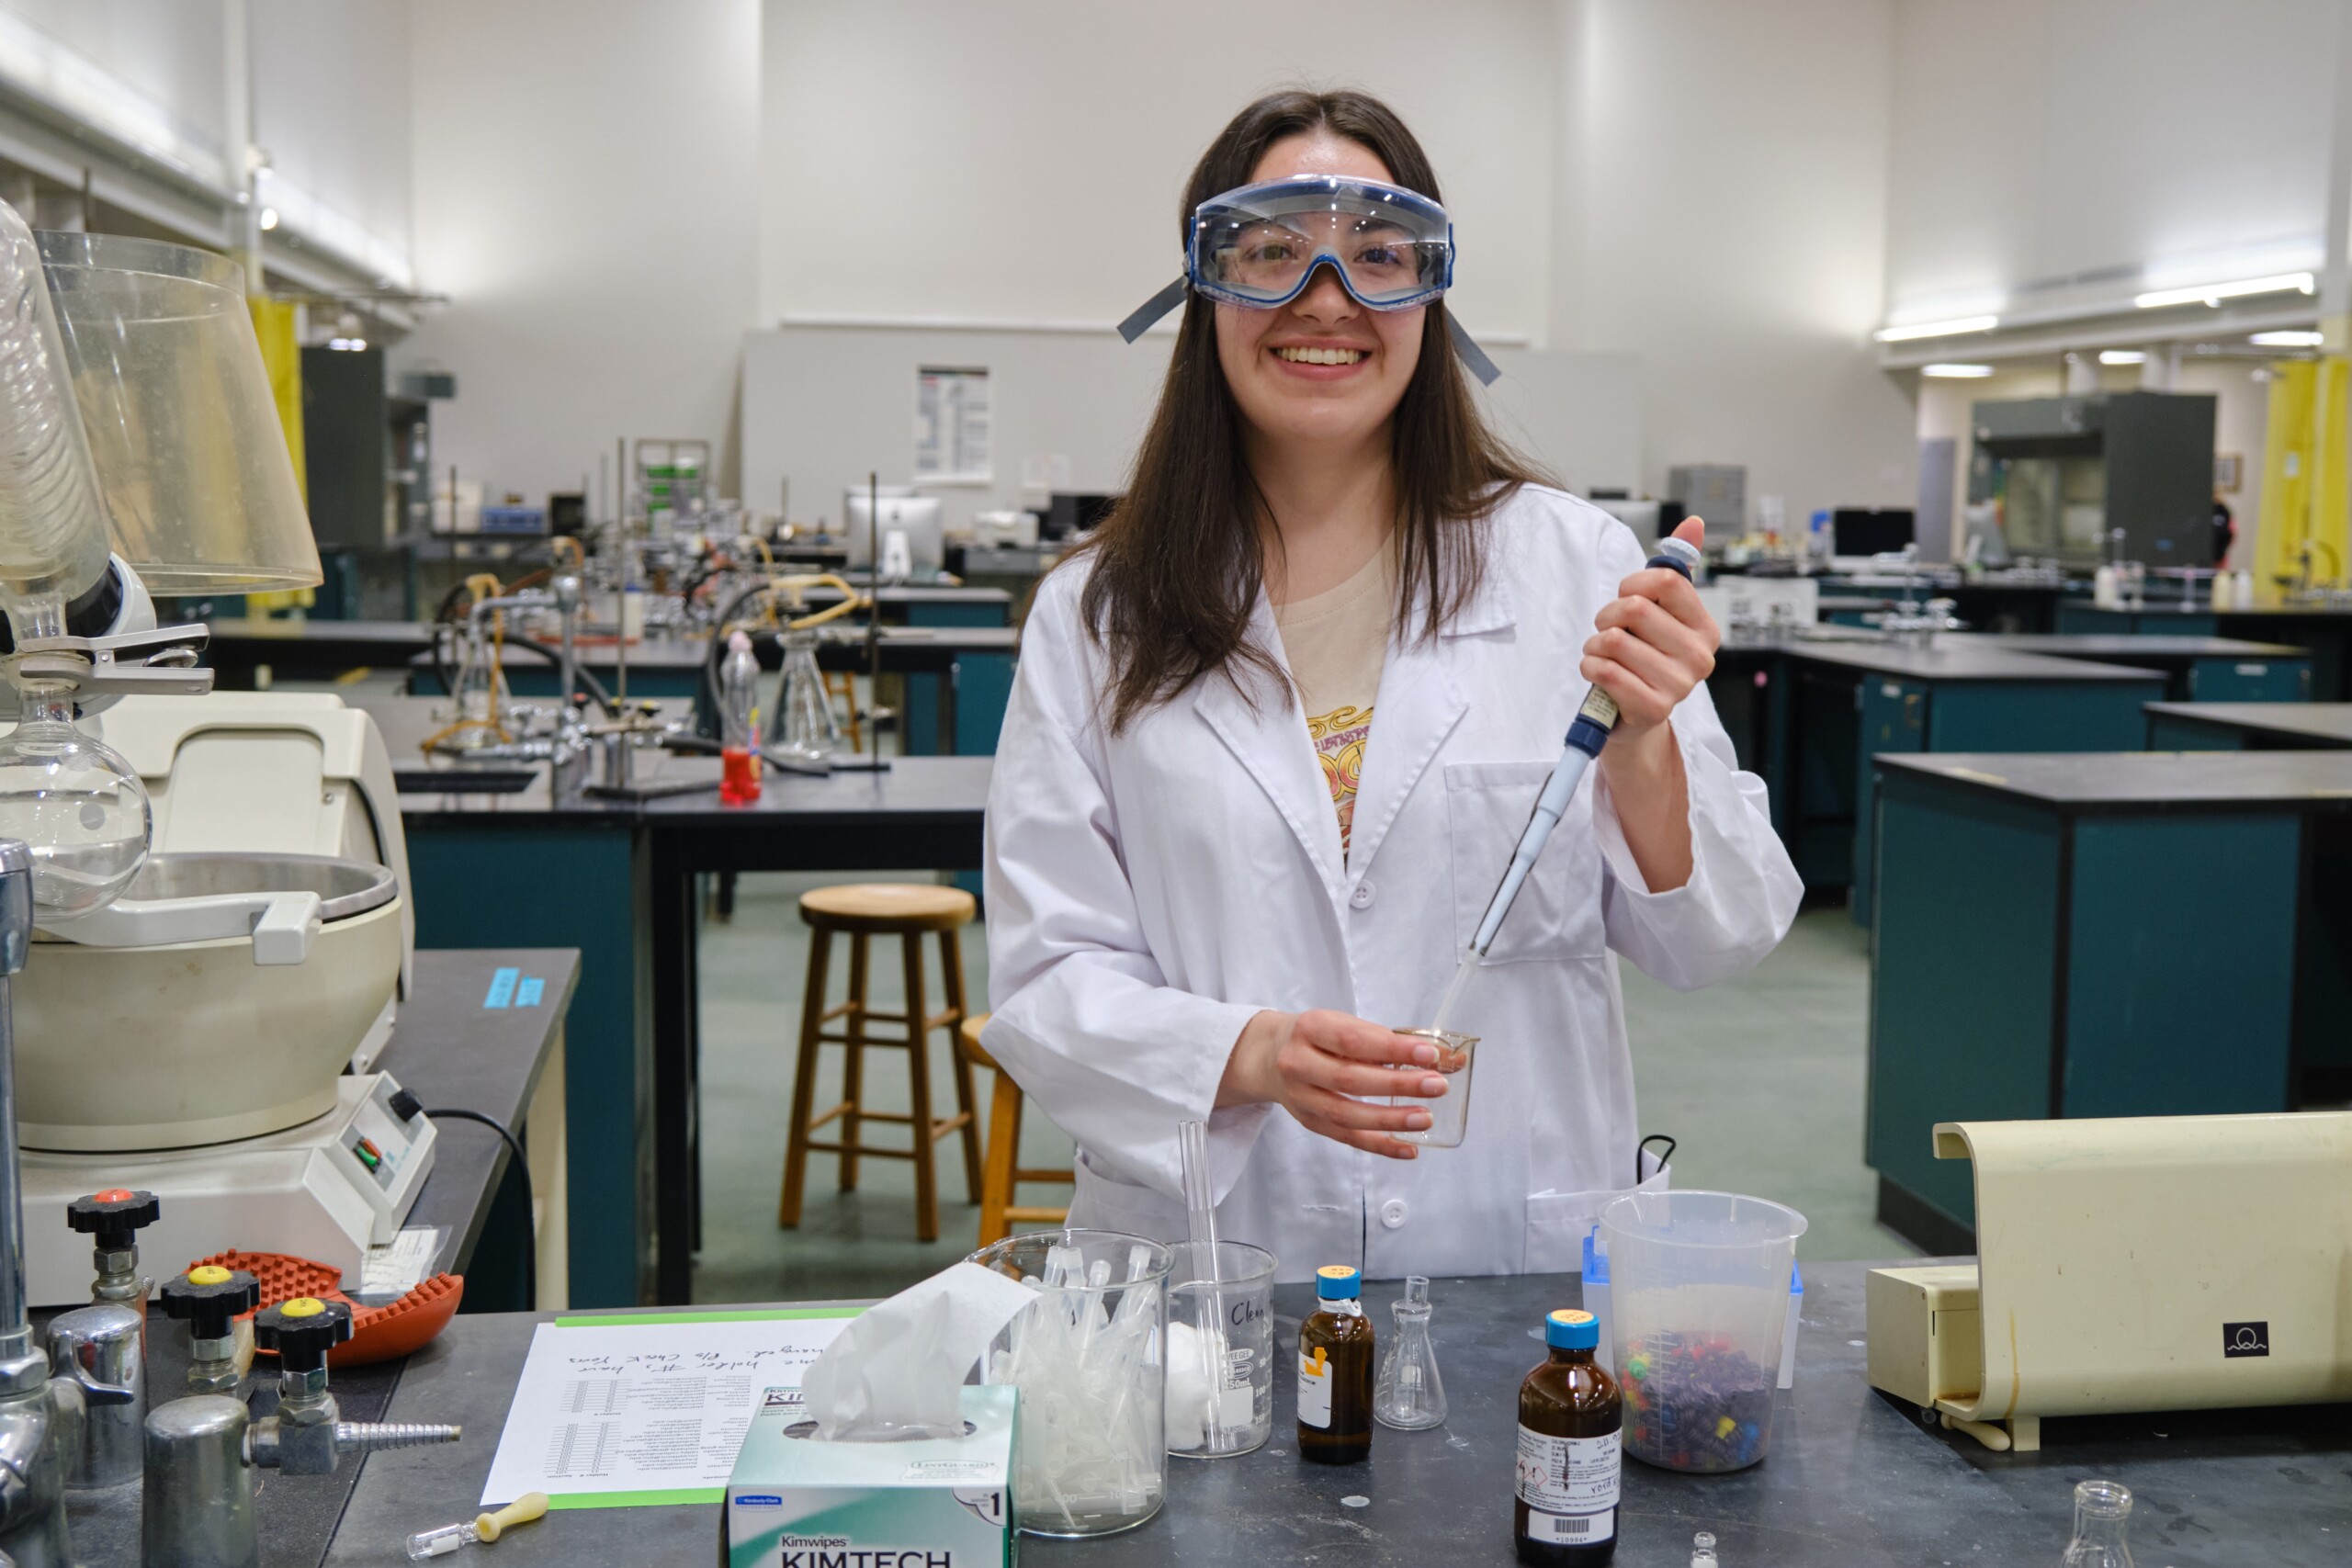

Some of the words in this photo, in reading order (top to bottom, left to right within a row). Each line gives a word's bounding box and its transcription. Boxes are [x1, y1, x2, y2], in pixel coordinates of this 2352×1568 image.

[1231, 1301, 1265, 1325] Clean
[990, 1492, 1000, 1517] 1
[781, 1535, 847, 1548] Kimwipes
